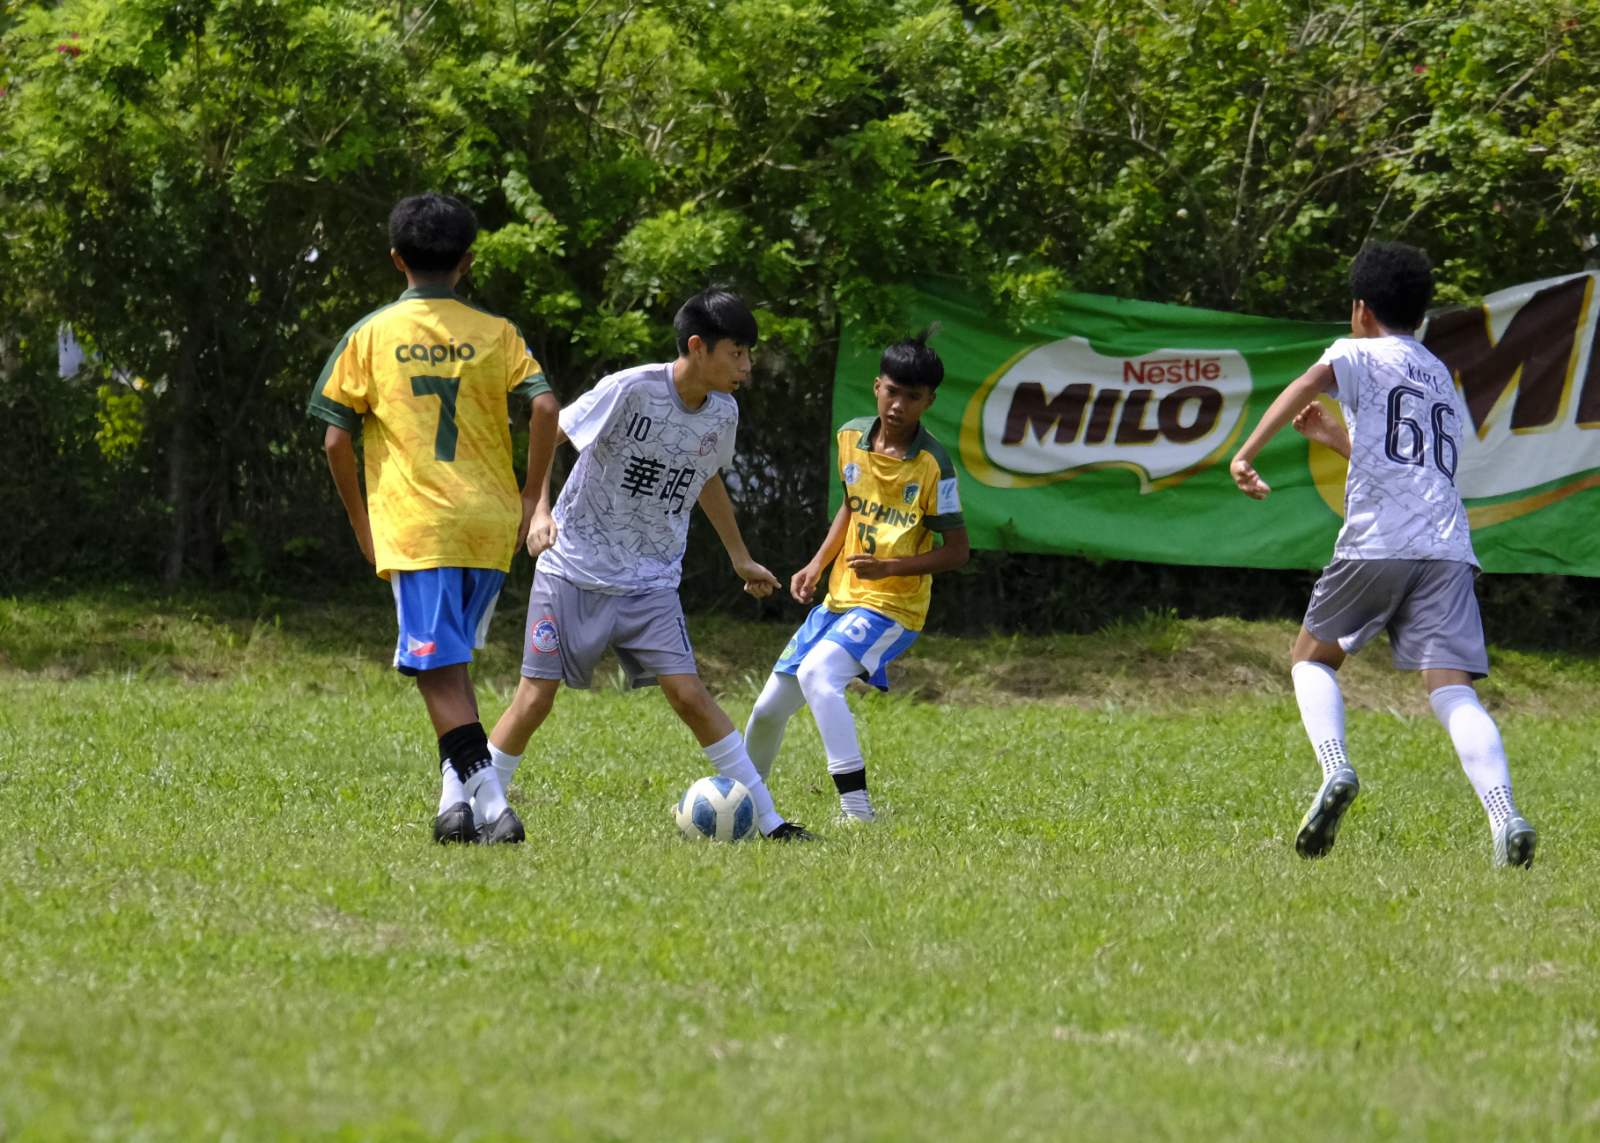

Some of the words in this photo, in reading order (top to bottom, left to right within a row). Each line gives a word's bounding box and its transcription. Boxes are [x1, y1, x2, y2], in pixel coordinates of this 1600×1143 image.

[394, 337, 476, 367] capio
[409, 375, 461, 462] 7
[625, 412, 651, 442] 10
[1000, 381, 1224, 446] MILO
[1384, 384, 1458, 488] 66
[619, 455, 697, 515] 華明
[848, 495, 917, 529] OLPHINS
[857, 522, 878, 555] 15
[835, 613, 872, 643] 15
